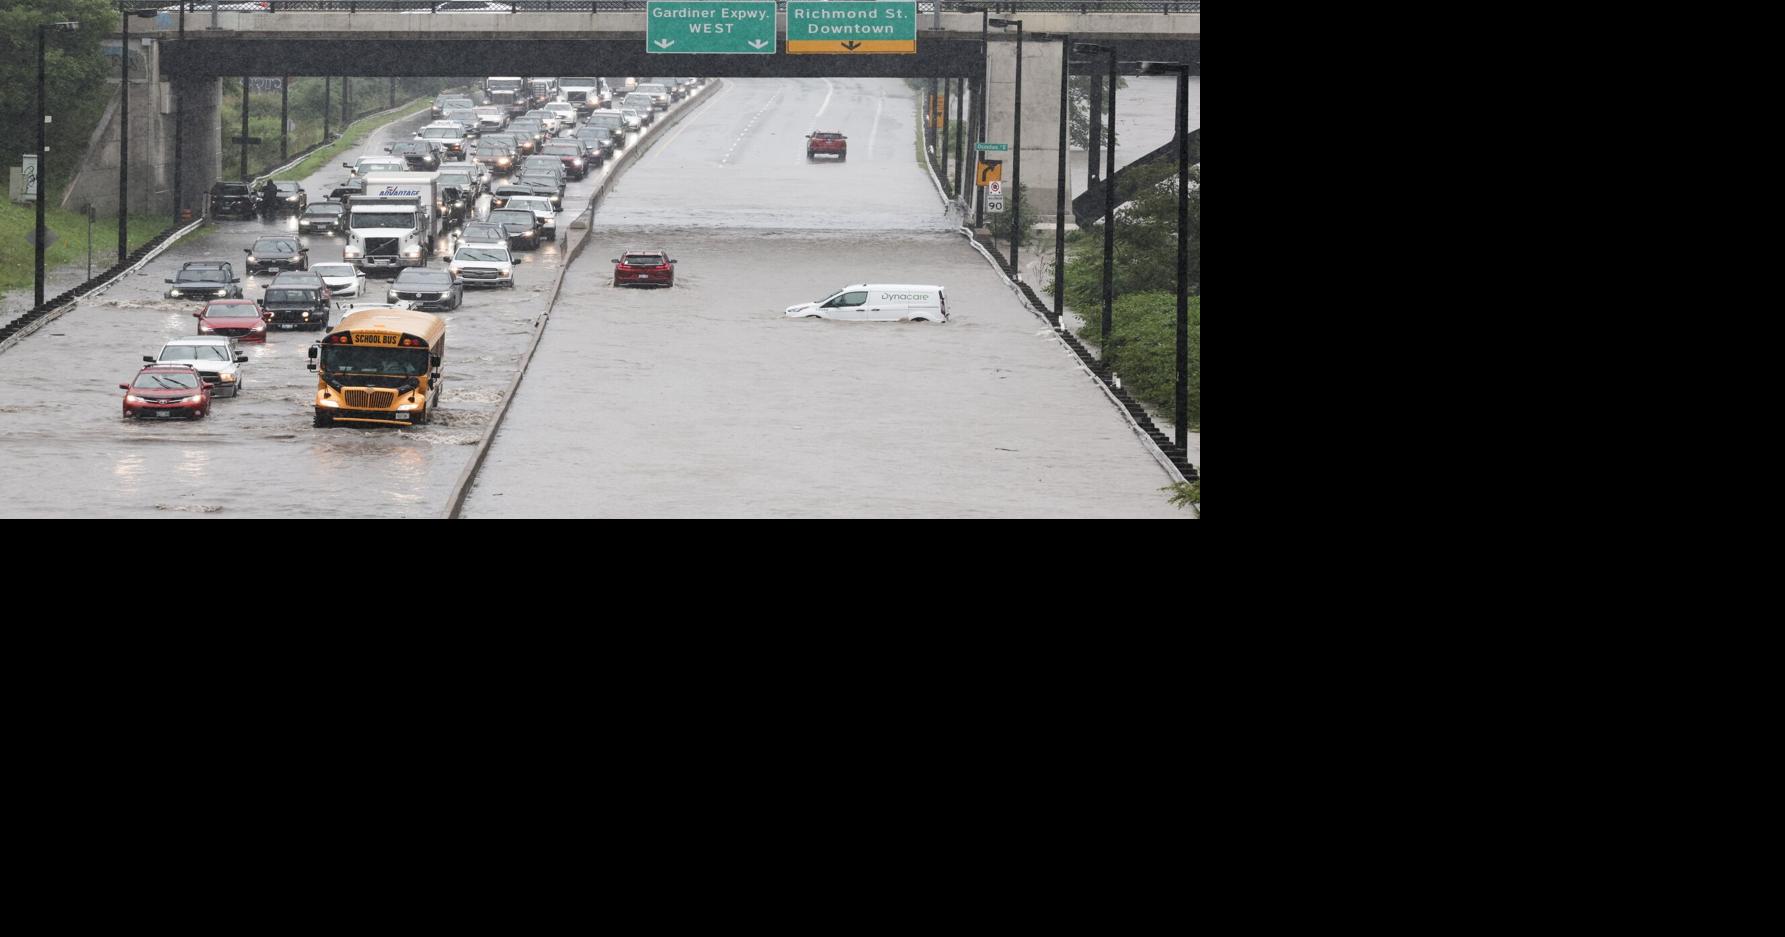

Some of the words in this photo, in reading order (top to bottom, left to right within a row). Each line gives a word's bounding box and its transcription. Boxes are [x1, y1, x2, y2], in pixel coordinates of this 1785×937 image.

[652, 7, 715, 18] Gardiner
[721, 8, 769, 20] Expwy.
[795, 8, 877, 19] Richmond
[885, 8, 908, 19] St.
[689, 23, 734, 33] WEST
[808, 23, 894, 34] Downtown
[988, 202, 1003, 210] 90
[881, 292, 929, 301] Dynacare
[355, 334, 382, 344] SCHOOL
[383, 335, 397, 345] BUS
